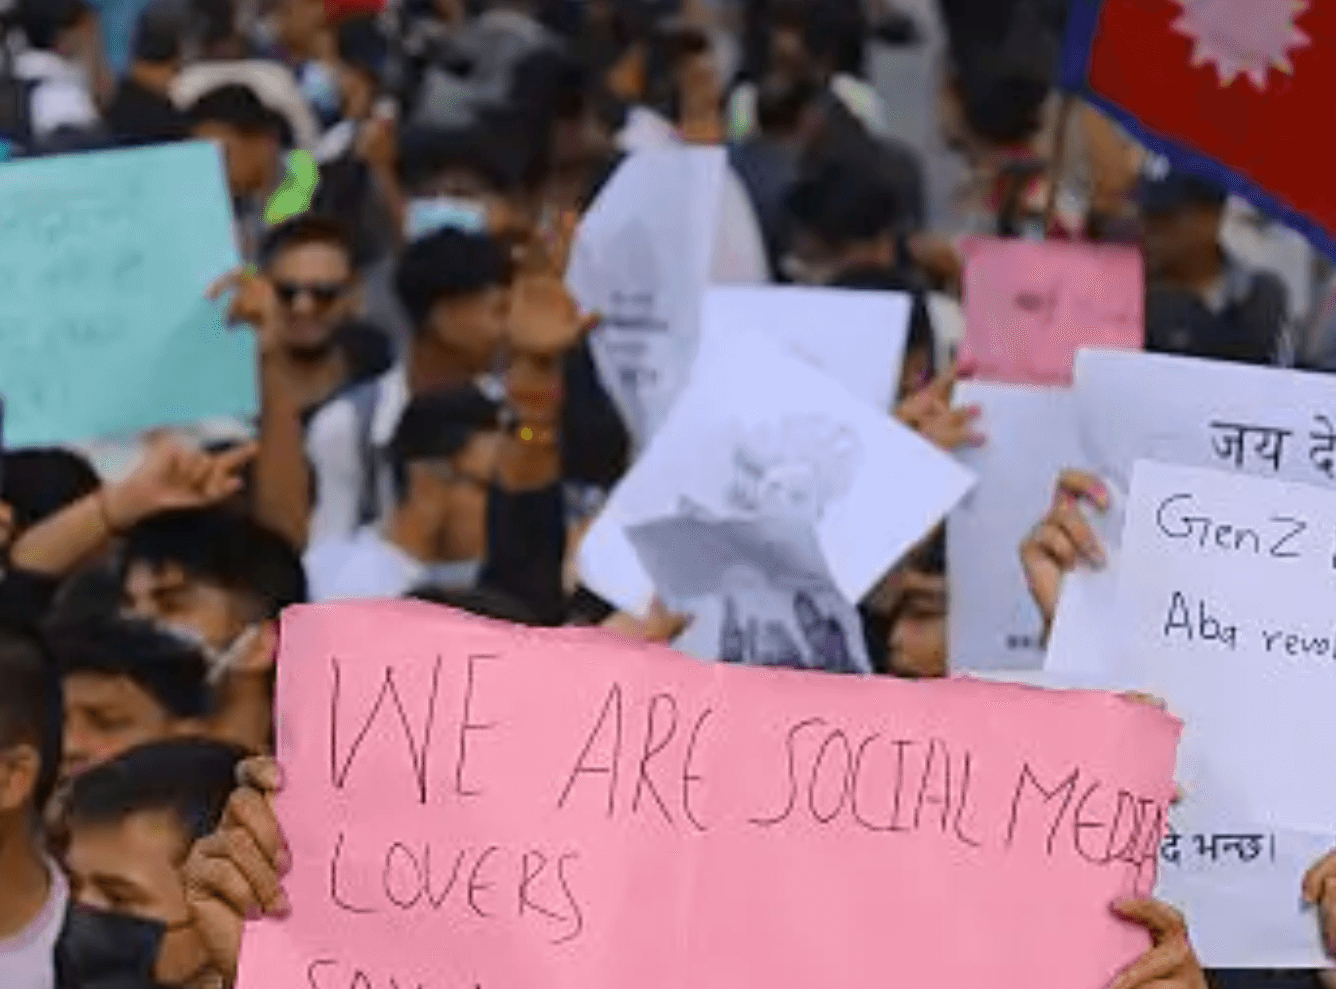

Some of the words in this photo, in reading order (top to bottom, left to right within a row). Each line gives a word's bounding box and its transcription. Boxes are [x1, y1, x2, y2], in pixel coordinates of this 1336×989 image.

[1210, 421, 1293, 470] जय
[1164, 590, 1237, 650] Aba
[331, 653, 500, 805] WE
[558, 681, 713, 832] ARE
[747, 717, 981, 848] SOCIAL
[331, 832, 583, 945] LOVERS
